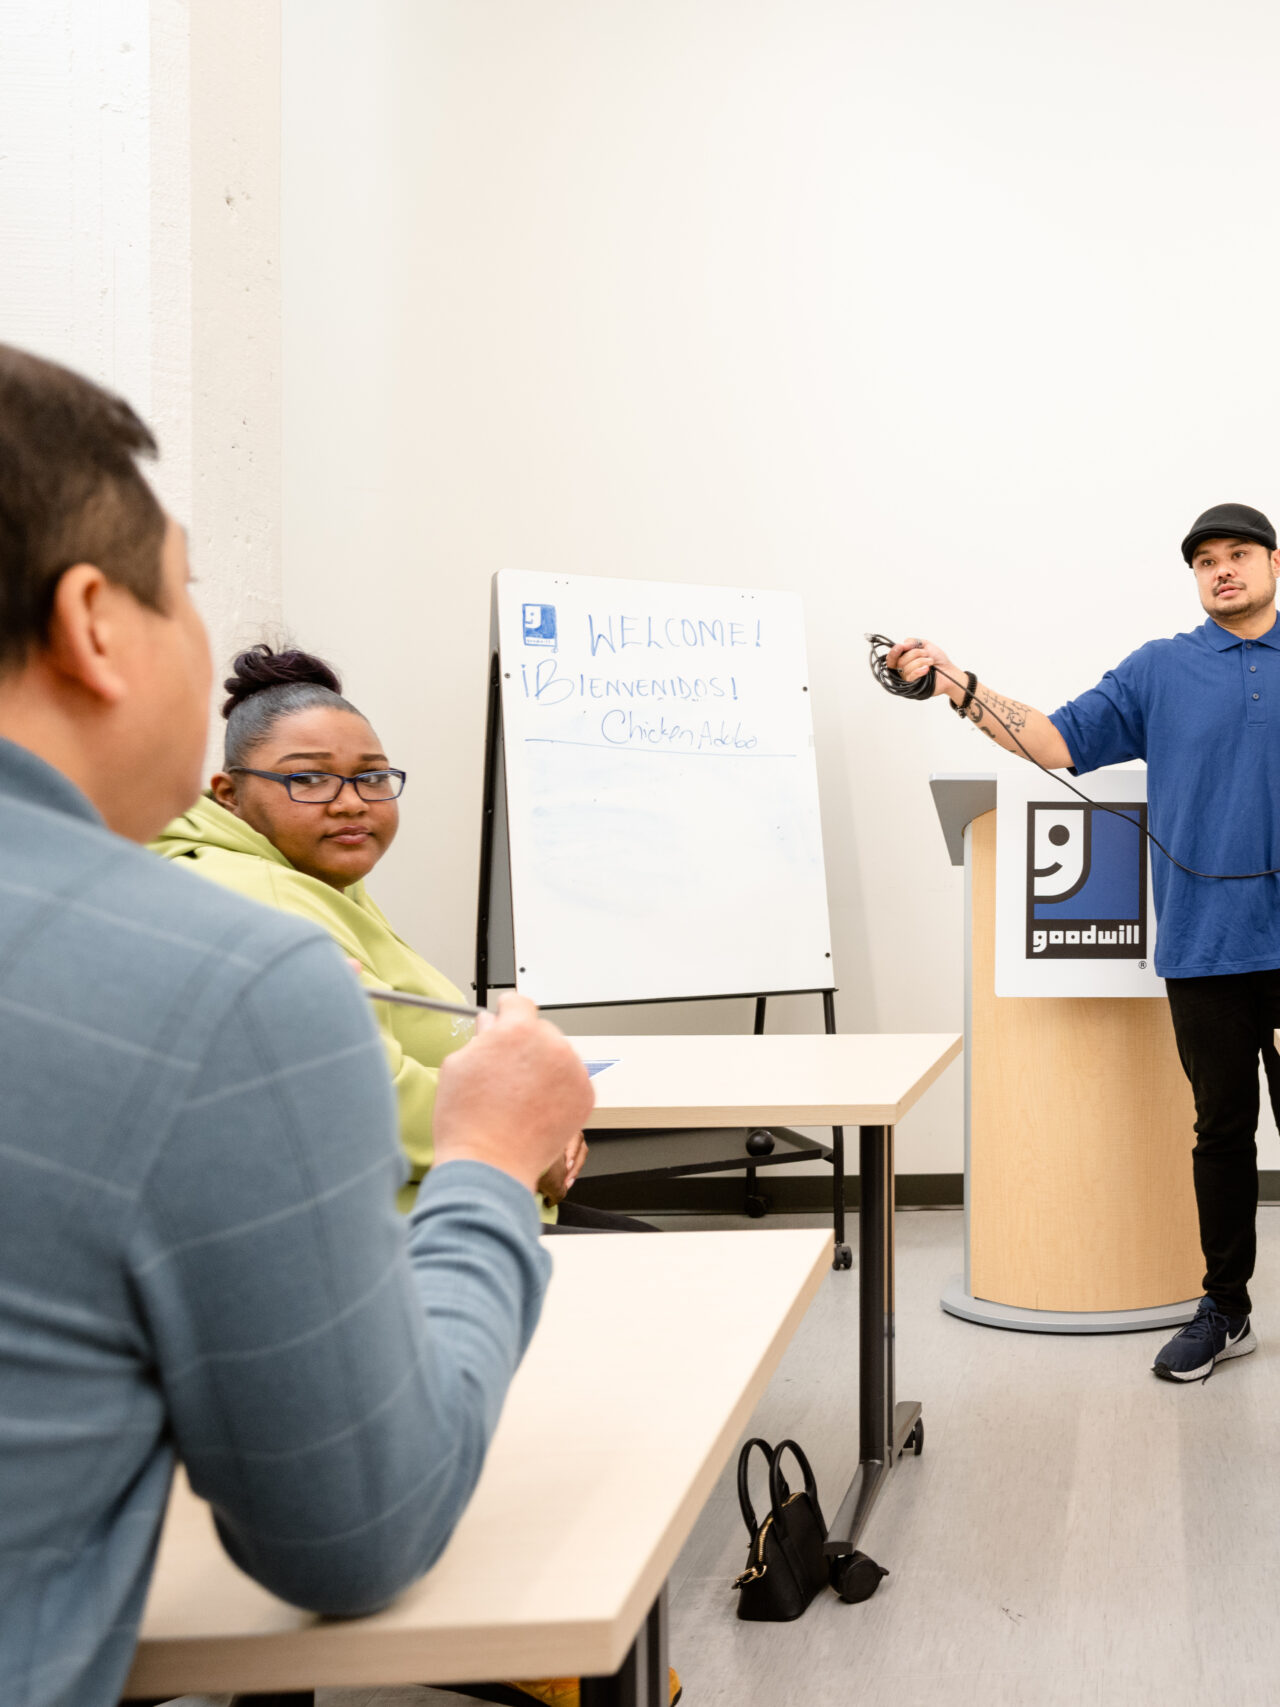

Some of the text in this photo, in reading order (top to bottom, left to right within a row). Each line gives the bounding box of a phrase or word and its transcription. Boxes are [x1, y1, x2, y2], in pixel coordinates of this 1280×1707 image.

[588, 614, 761, 656] WELCOME!
[602, 710, 694, 744] Chicken
[1033, 925, 1139, 952] goodwill
